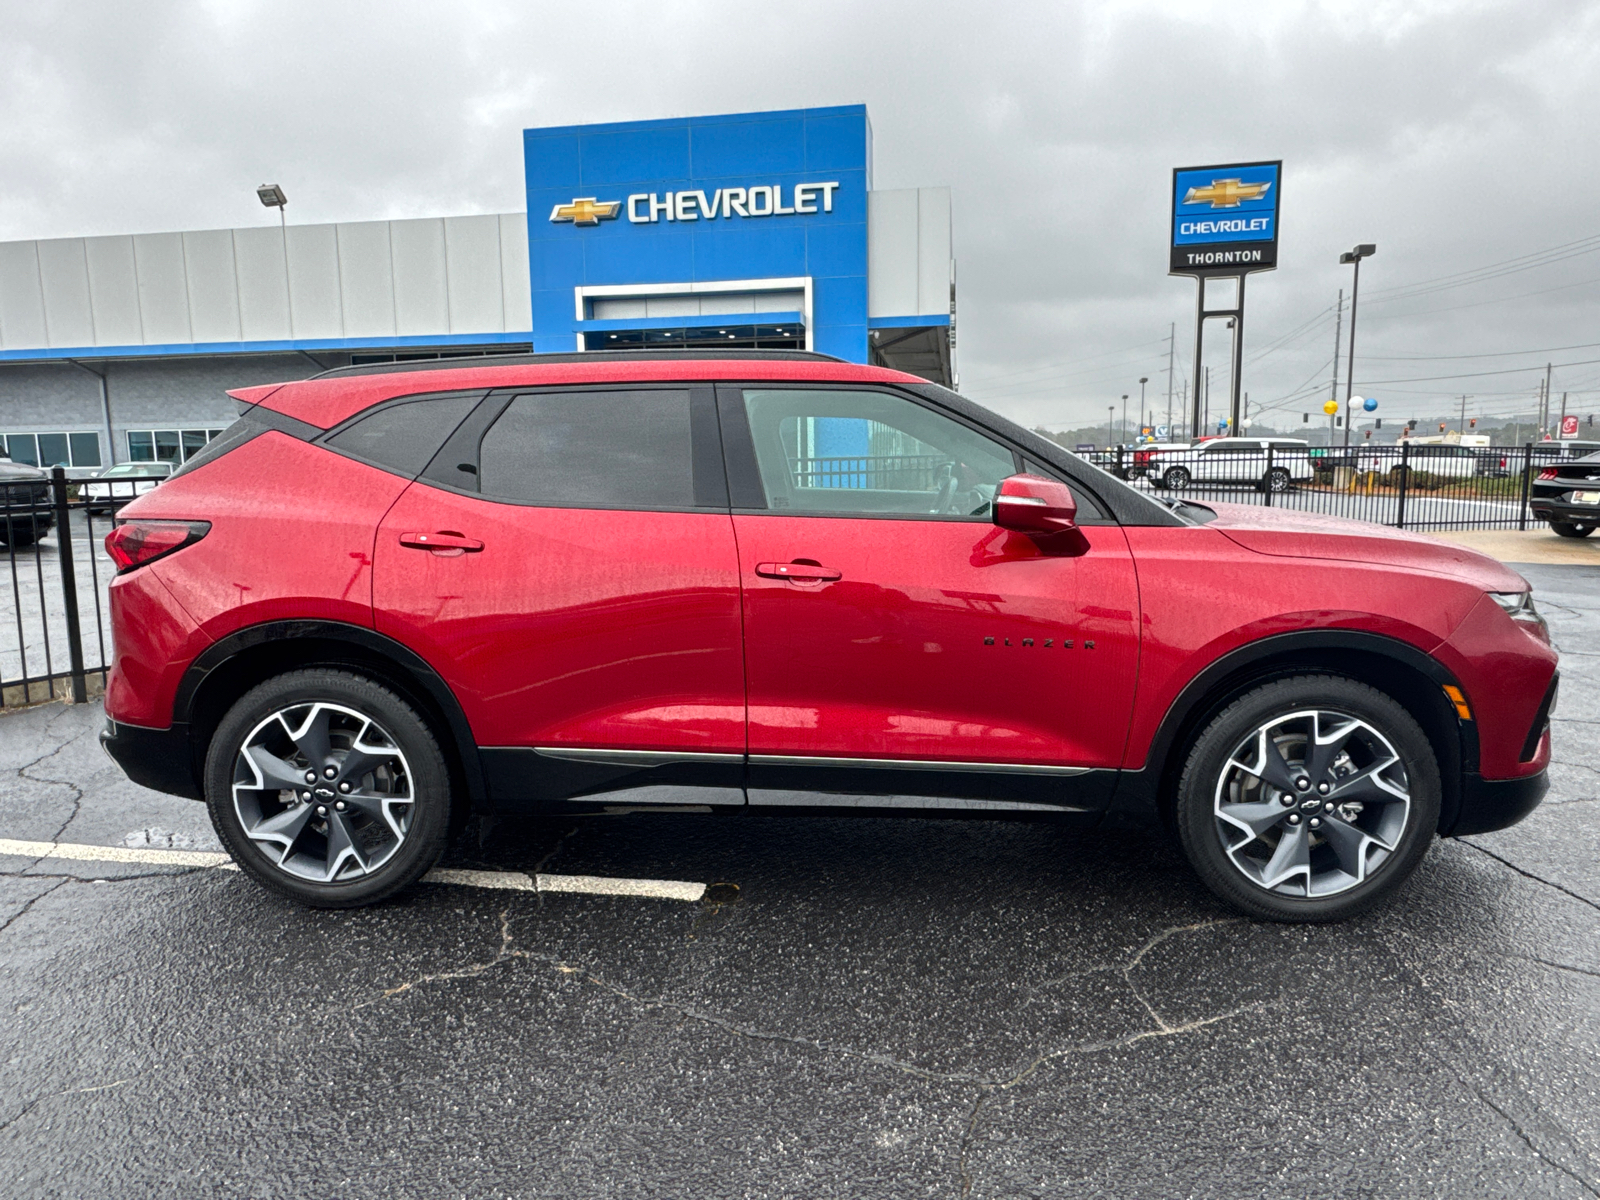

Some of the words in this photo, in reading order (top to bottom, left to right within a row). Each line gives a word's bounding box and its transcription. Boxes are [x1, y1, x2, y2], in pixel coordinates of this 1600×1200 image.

[627, 181, 840, 224] CHEVROLET
[1180, 217, 1270, 235] CHEVROLET
[1187, 250, 1262, 265] THORNTON
[983, 636, 1096, 650] BLAZER
